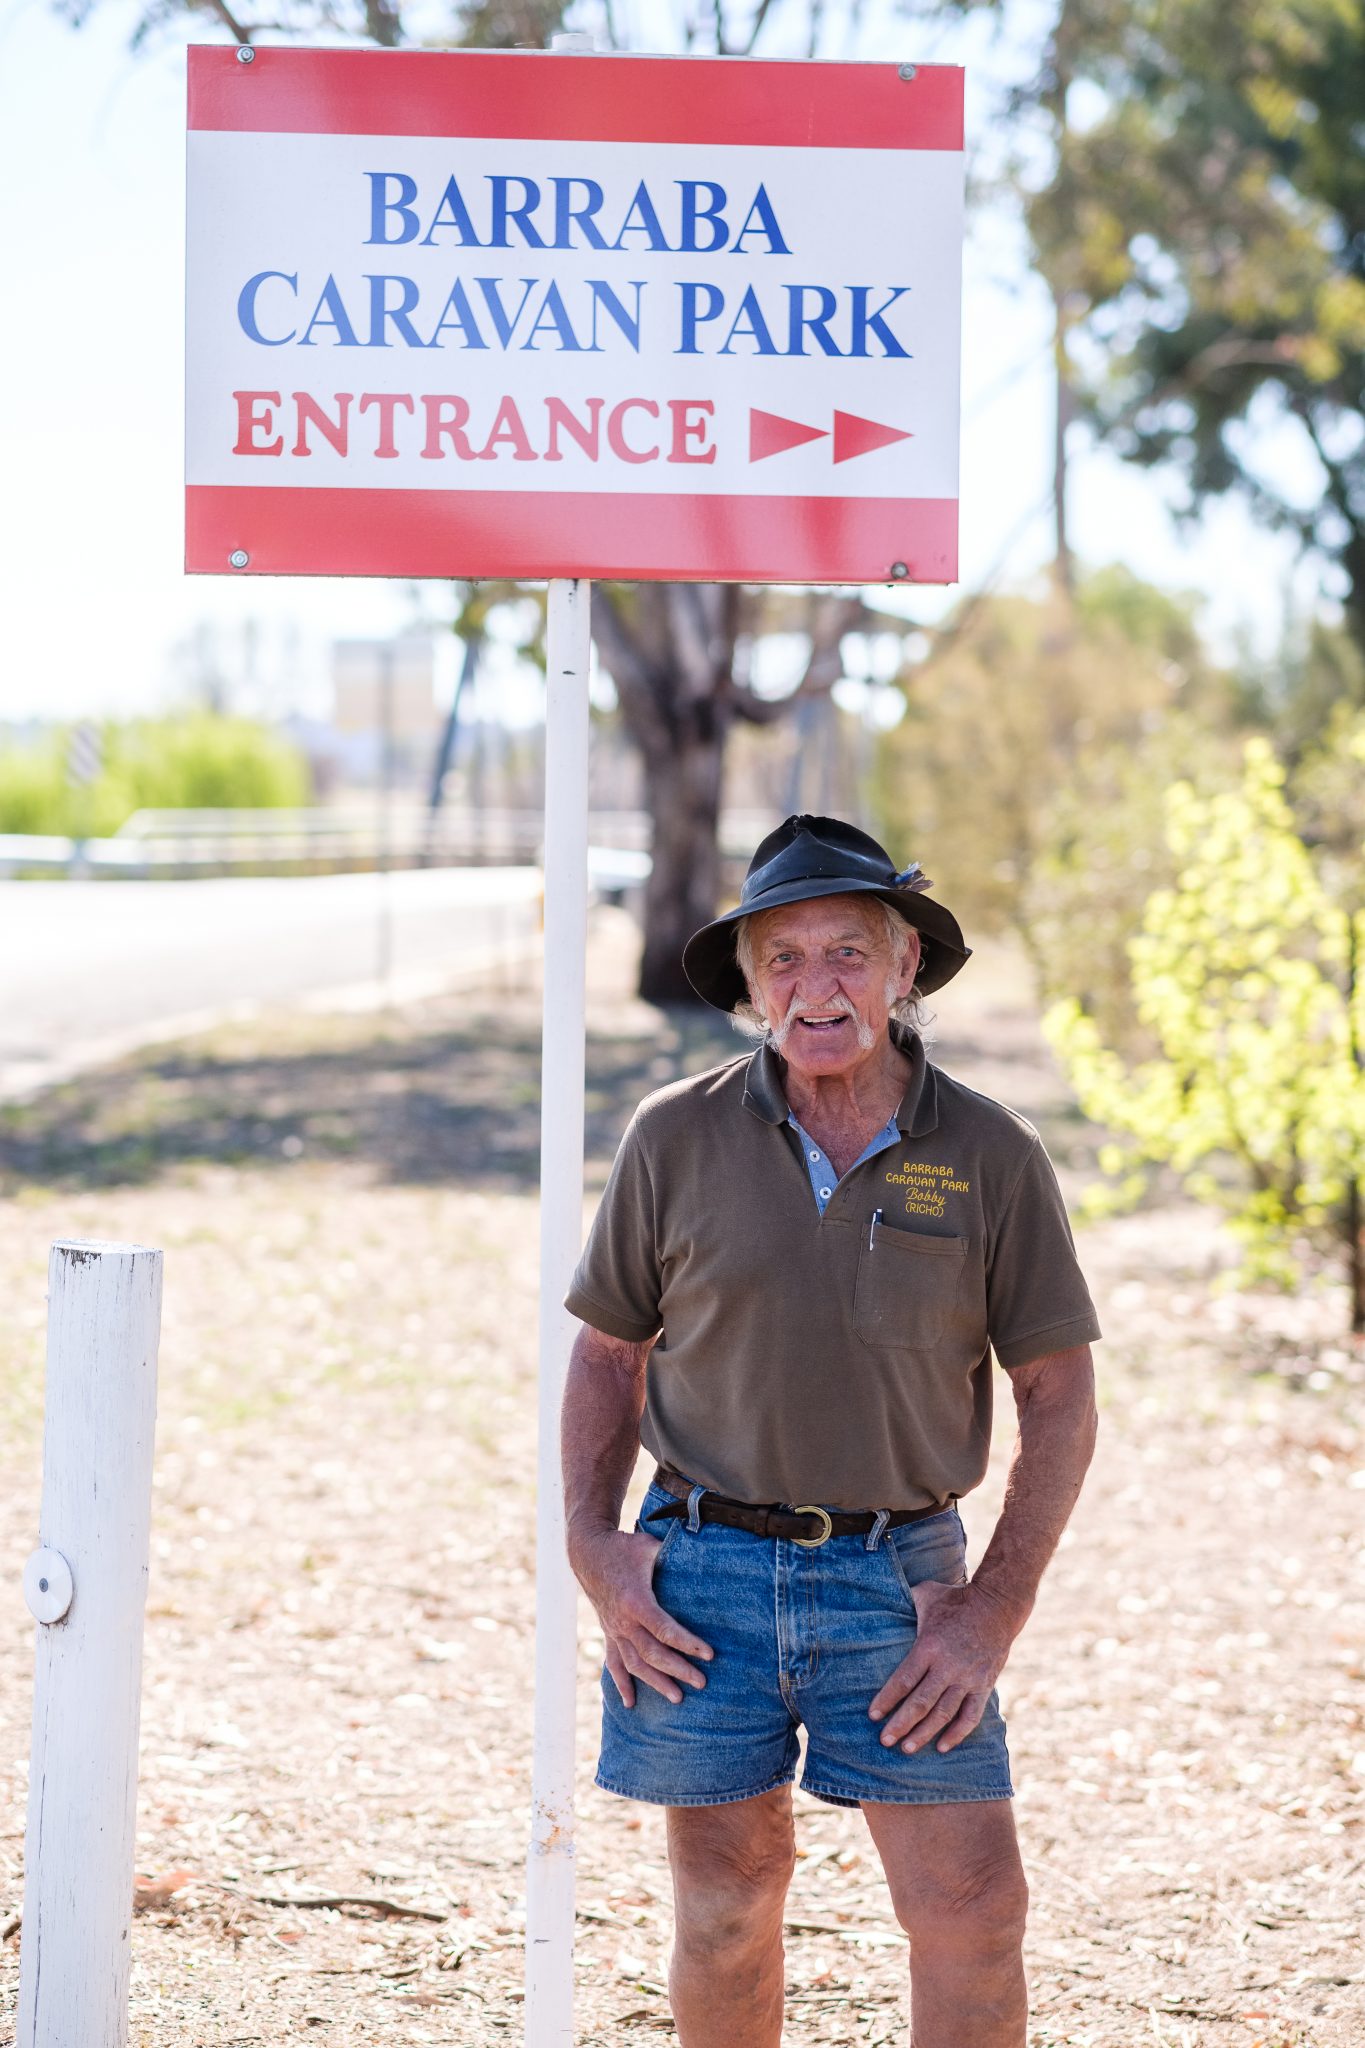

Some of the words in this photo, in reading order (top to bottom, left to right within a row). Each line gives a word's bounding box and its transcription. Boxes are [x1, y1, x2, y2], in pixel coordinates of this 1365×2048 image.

[362, 172, 793, 255] BARRABA
[237, 271, 648, 354] CARAVAN
[673, 282, 913, 359] PARK
[232, 390, 717, 464] ENTRANCE
[903, 1162, 954, 1178] BARRABA
[885, 1172, 936, 1188] CARAVAN
[941, 1179, 970, 1192] PARK
[905, 1187, 947, 1206] Bobby
[905, 1201, 944, 1217] (RICHO)
